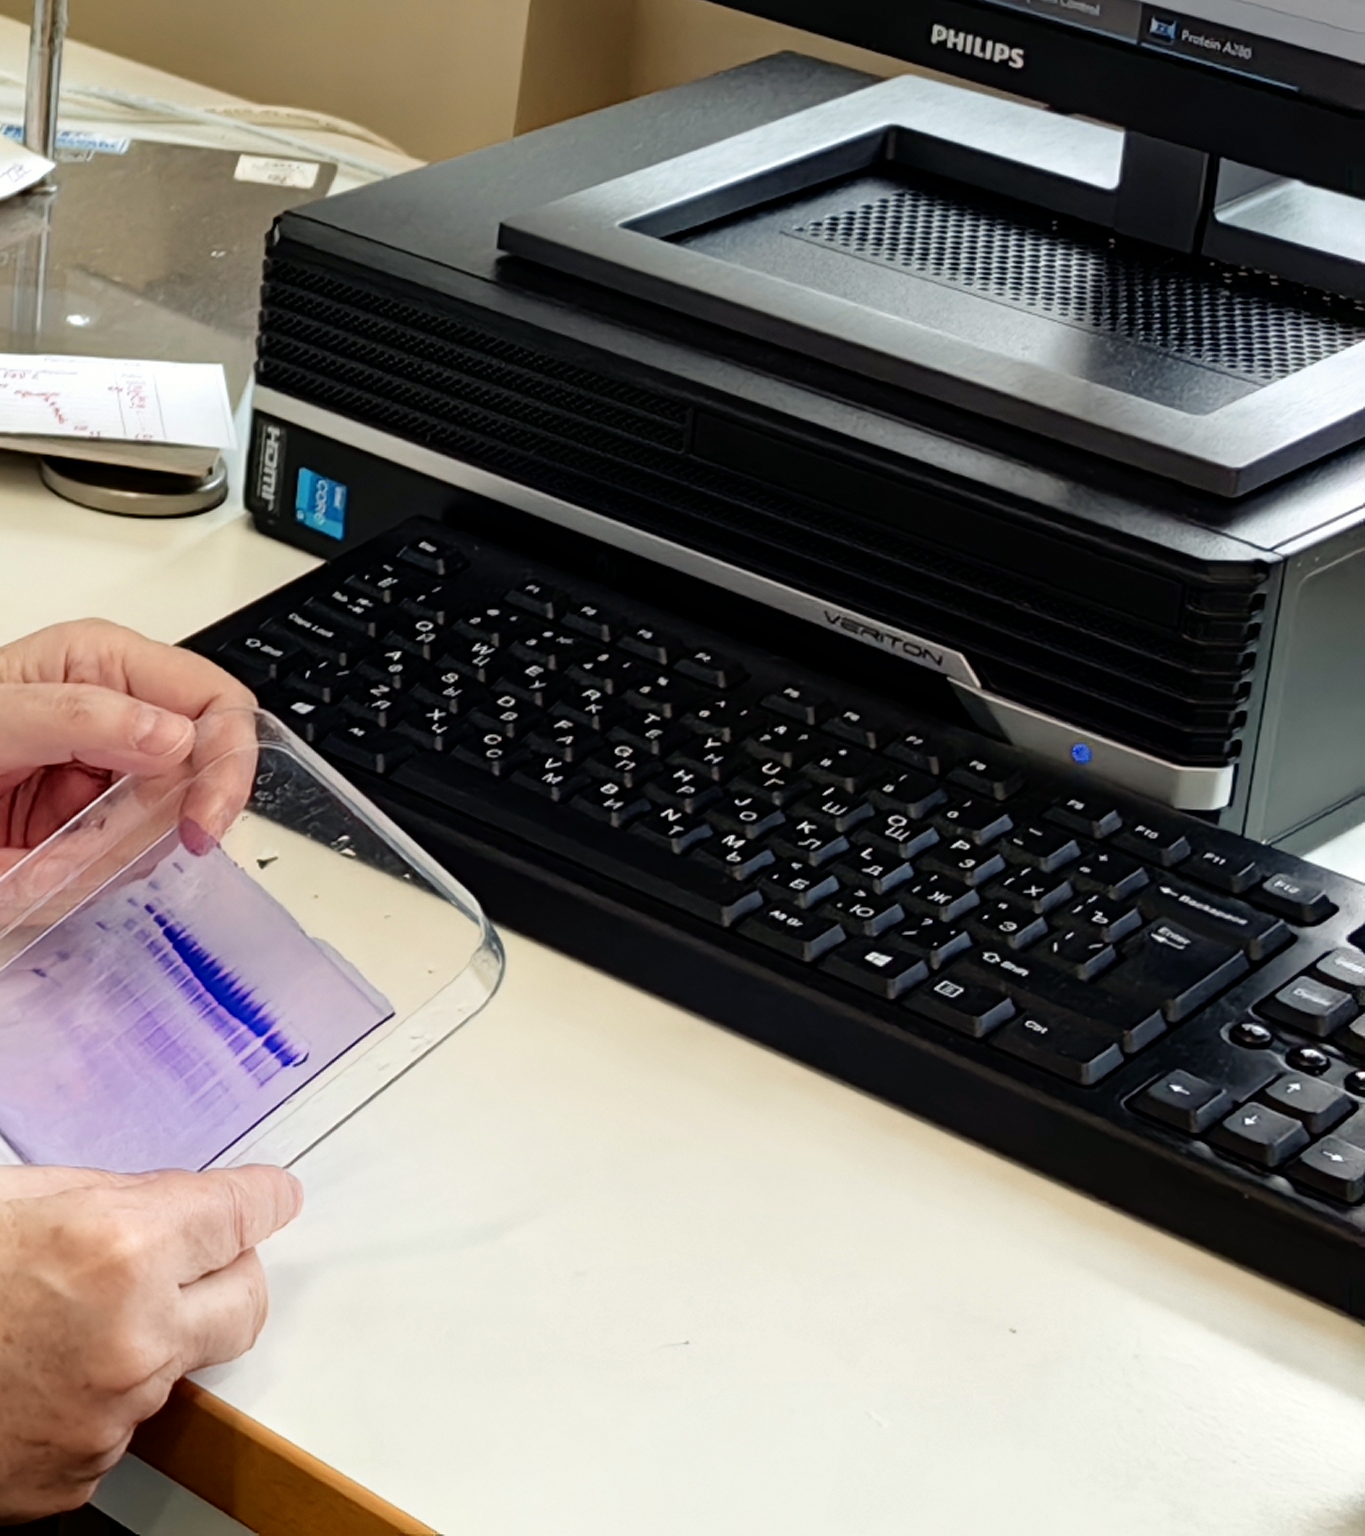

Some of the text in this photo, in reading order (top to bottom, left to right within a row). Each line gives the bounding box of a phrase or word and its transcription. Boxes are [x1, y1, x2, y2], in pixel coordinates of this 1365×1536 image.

[930, 22, 1026, 70] PHILIPS
[1180, 28, 1223, 56] Protein
[823, 610, 944, 666] VERITON
[471, 642, 495, 655] W
[441, 672, 459, 684] S
[425, 709, 447, 721] X
[703, 737, 722, 749] Y
[614, 746, 633, 758] G
[545, 758, 563, 770] V
[761, 762, 781, 775] U
[672, 770, 695, 782] H
[600, 783, 619, 795] B
[734, 797, 753, 806] J
[821, 801, 849, 815] Ш
[660, 808, 682, 822] N
[796, 820, 818, 834] K
[721, 834, 746, 849] M
[949, 839, 971, 851] P
[860, 847, 874, 860] L
[926, 890, 953, 905] Ж
[849, 903, 875, 918] Ю
[1177, 893, 1250, 927] Backspace
[1090, 909, 1110, 925] Ъ
[998, 920, 1018, 933] Э
[1156, 925, 1193, 947] Enter
[999, 959, 1030, 977] Shift
